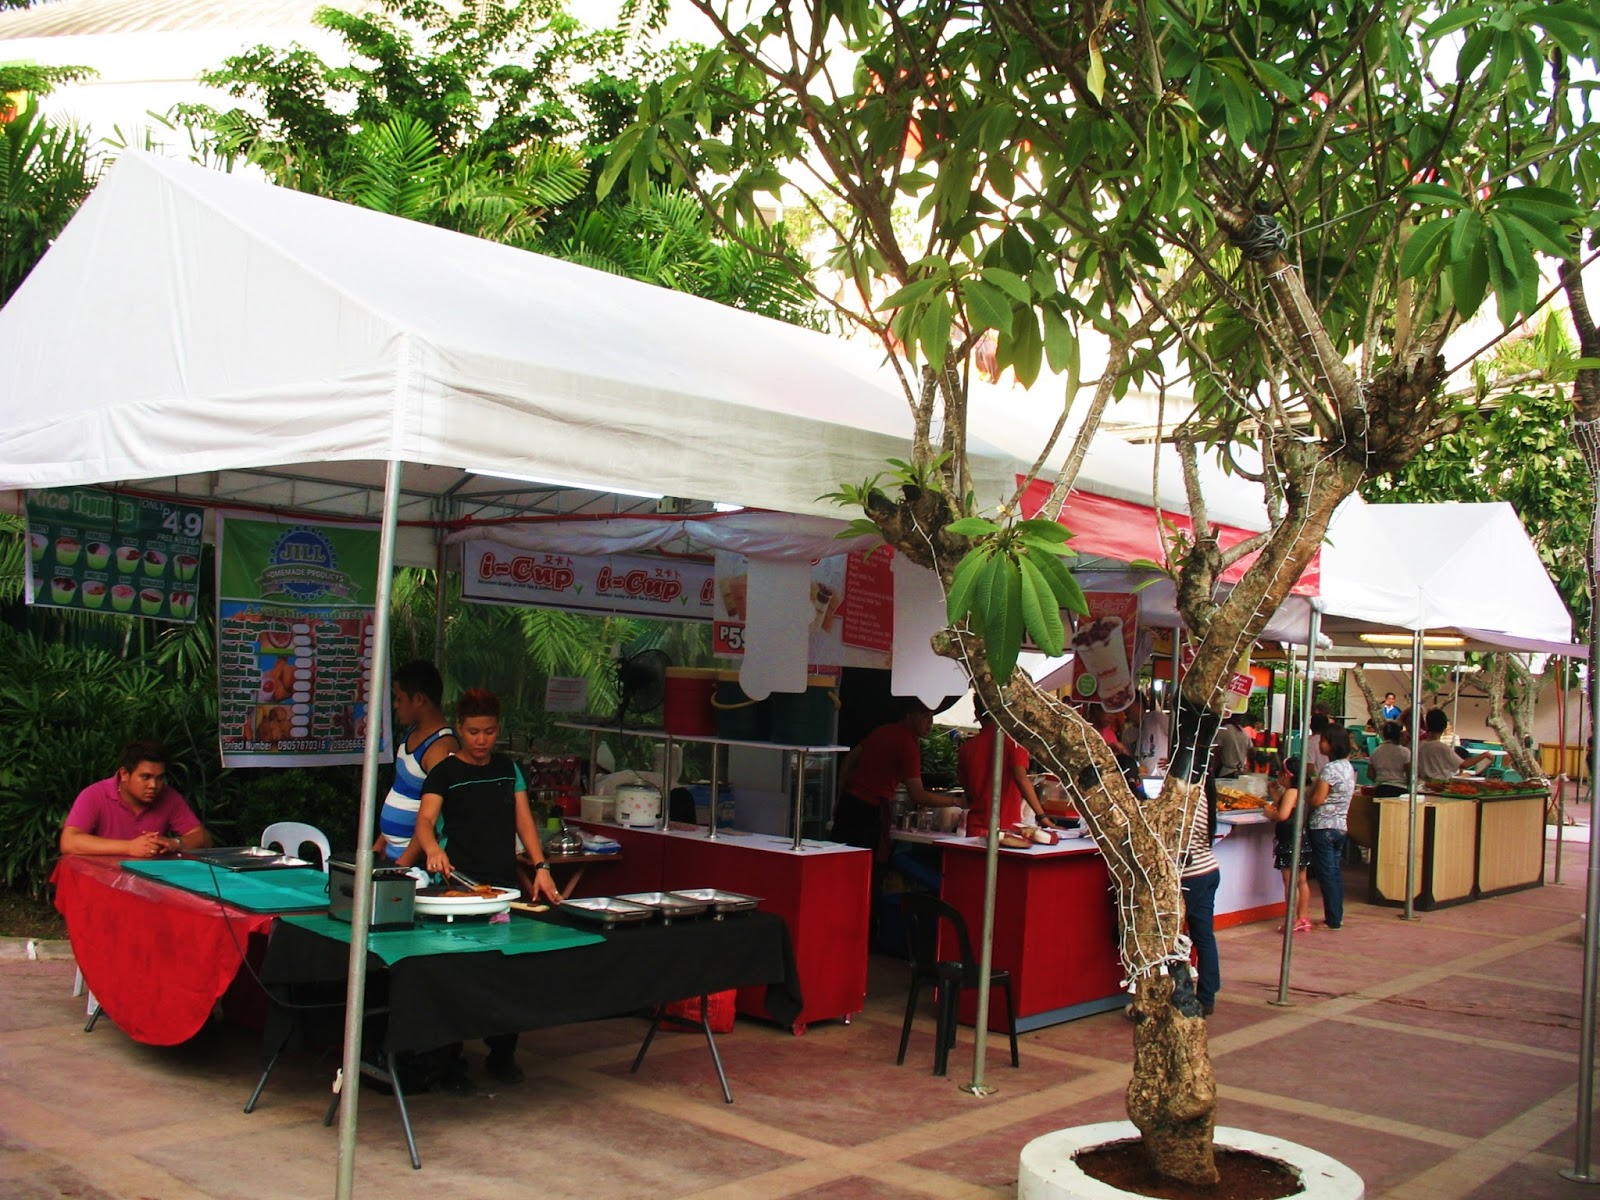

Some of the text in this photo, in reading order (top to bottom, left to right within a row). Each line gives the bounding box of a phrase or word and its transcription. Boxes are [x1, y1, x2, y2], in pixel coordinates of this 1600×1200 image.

[27, 489, 70, 510] Rice
[141, 500, 165, 511] ONLY
[156, 533, 174, 543] FREE
[279, 543, 326, 563] JILL
[266, 568, 345, 582] HOMEMADE PRODUCTS
[480, 552, 574, 592] i-Cup
[596, 566, 682, 603] i-Cup
[244, 604, 365, 619] Available products
[246, 740, 272, 750] Number
